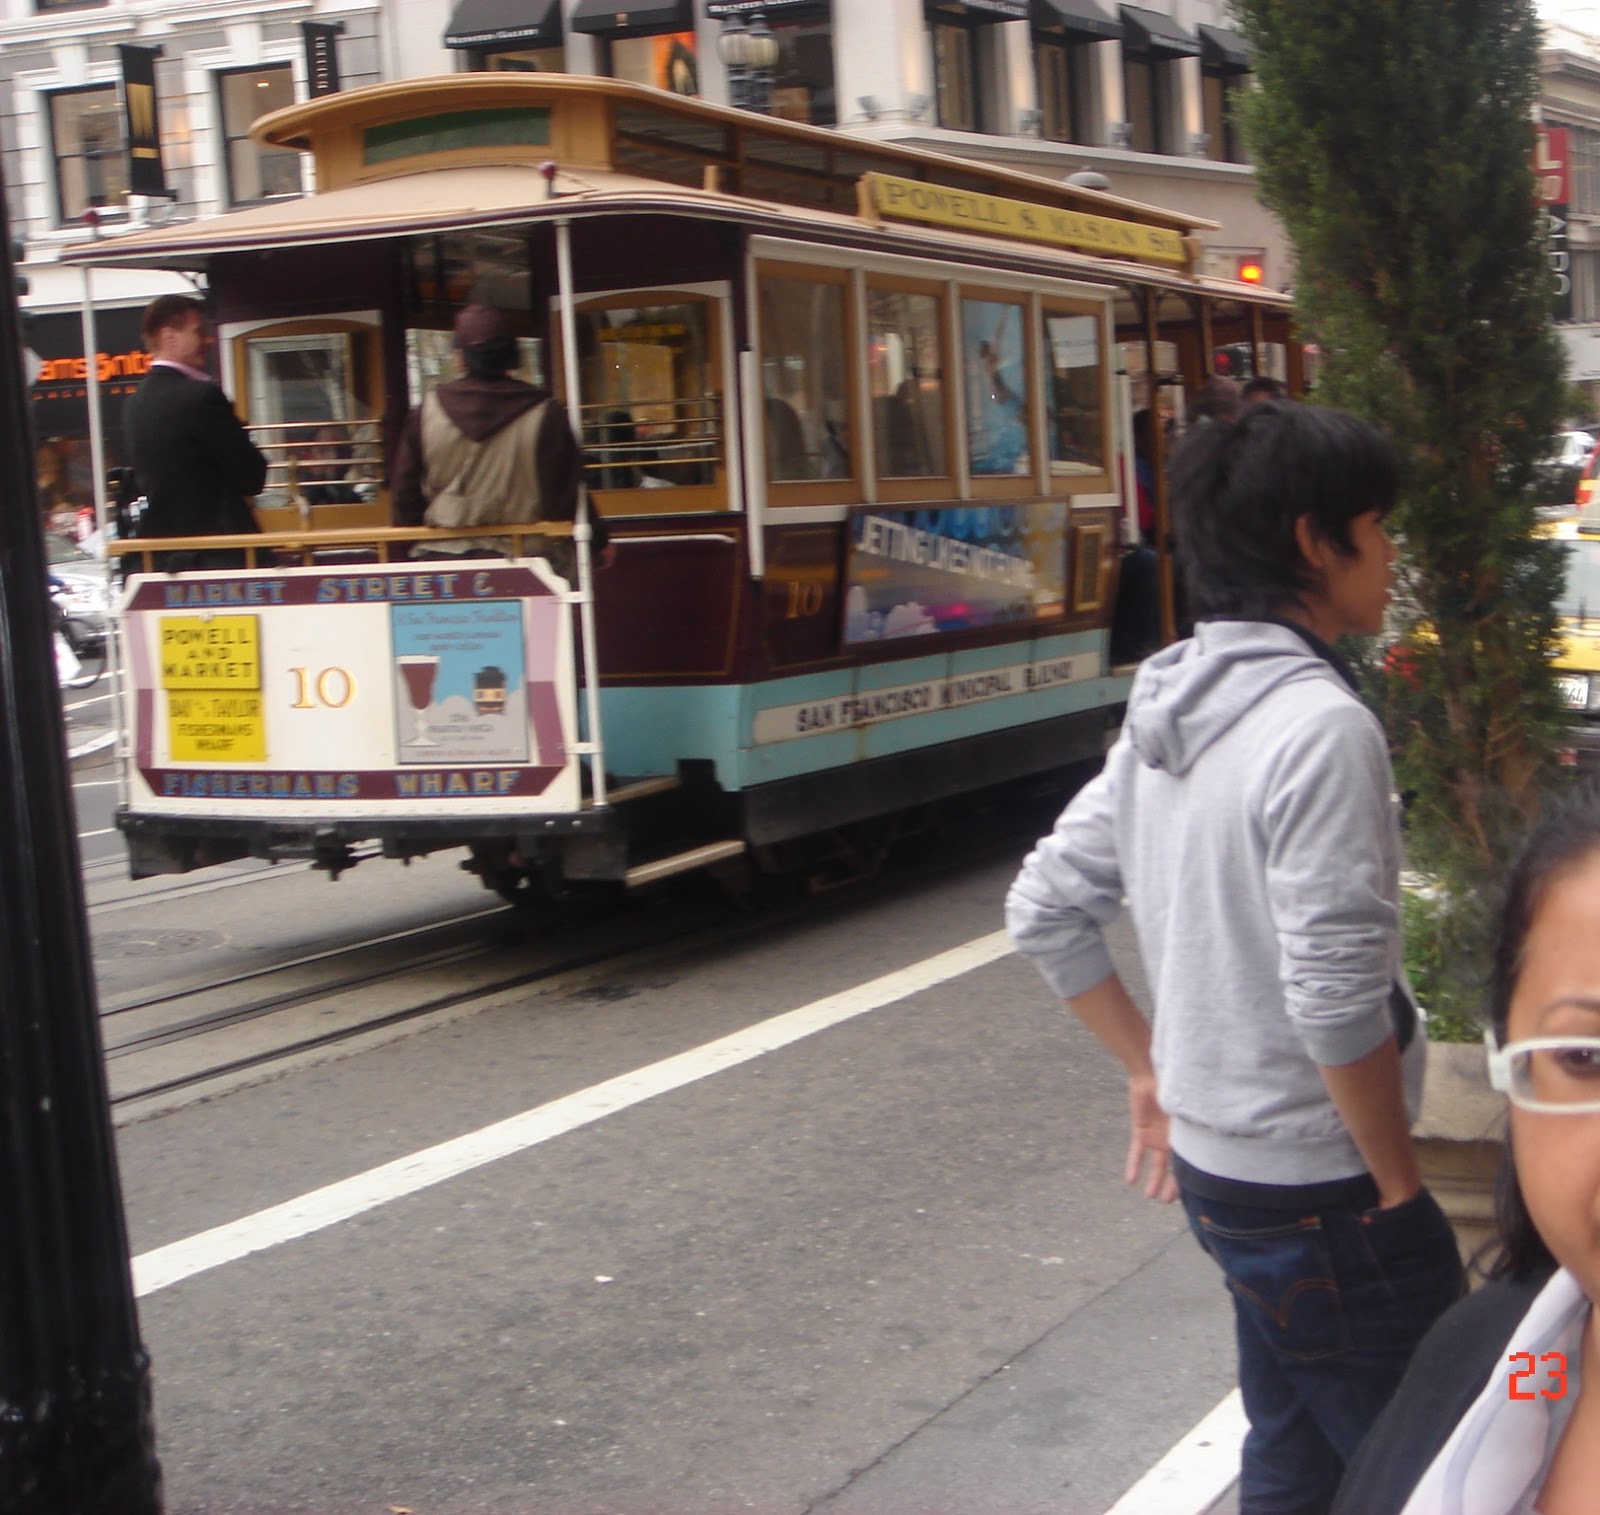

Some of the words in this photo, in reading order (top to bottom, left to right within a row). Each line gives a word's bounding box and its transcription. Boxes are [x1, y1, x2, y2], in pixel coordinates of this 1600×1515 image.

[883, 182, 1007, 226] POWELL
[1047, 212, 1137, 248] MASON
[163, 580, 287, 607] MARKET
[316, 573, 459, 602] STREET
[784, 580, 823, 619] 10
[163, 628, 252, 645] POWELL
[186, 647, 232, 660] AND
[163, 662, 254, 678] MARKET
[286, 665, 358, 709] 10
[795, 702, 834, 733] SAN
[840, 685, 933, 725] FRANCISCO
[163, 772, 361, 798] FISHERMANS
[395, 770, 522, 798] WHARF
